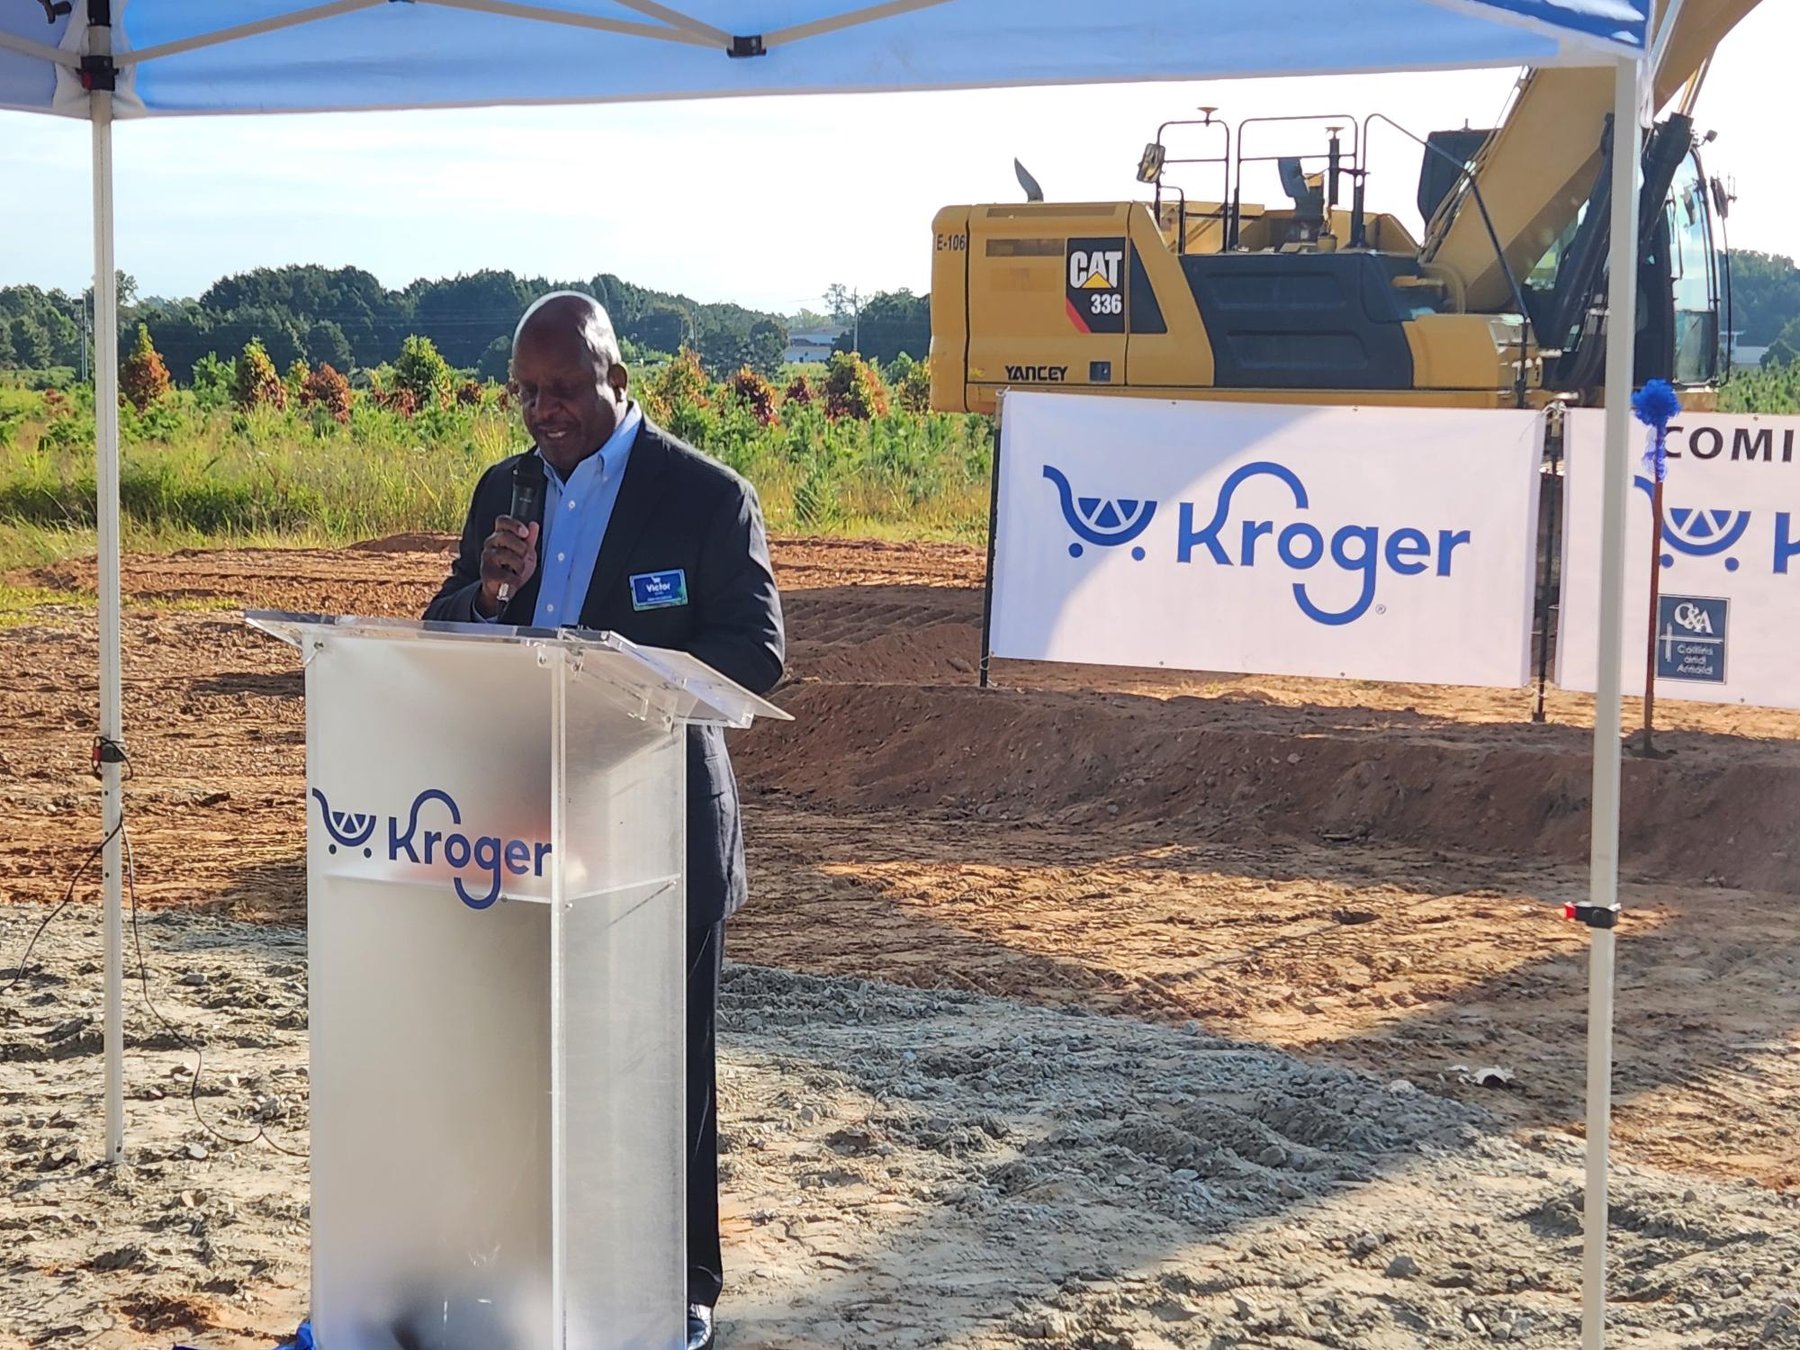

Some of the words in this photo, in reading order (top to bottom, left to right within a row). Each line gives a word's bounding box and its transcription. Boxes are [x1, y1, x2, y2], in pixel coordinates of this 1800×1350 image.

[936, 233, 966, 251] E-106
[1069, 250, 1122, 289] CAT
[1090, 293, 1122, 315] 336
[1004, 365, 1069, 382] YANCEY
[1176, 461, 1471, 626] Kroger
[645, 582, 671, 593] Victor
[1674, 601, 1714, 635] C&A
[1676, 644, 1714, 656] Collins
[1683, 655, 1707, 665] and
[1676, 664, 1714, 676] Arnold
[388, 788, 553, 911] Kroger
